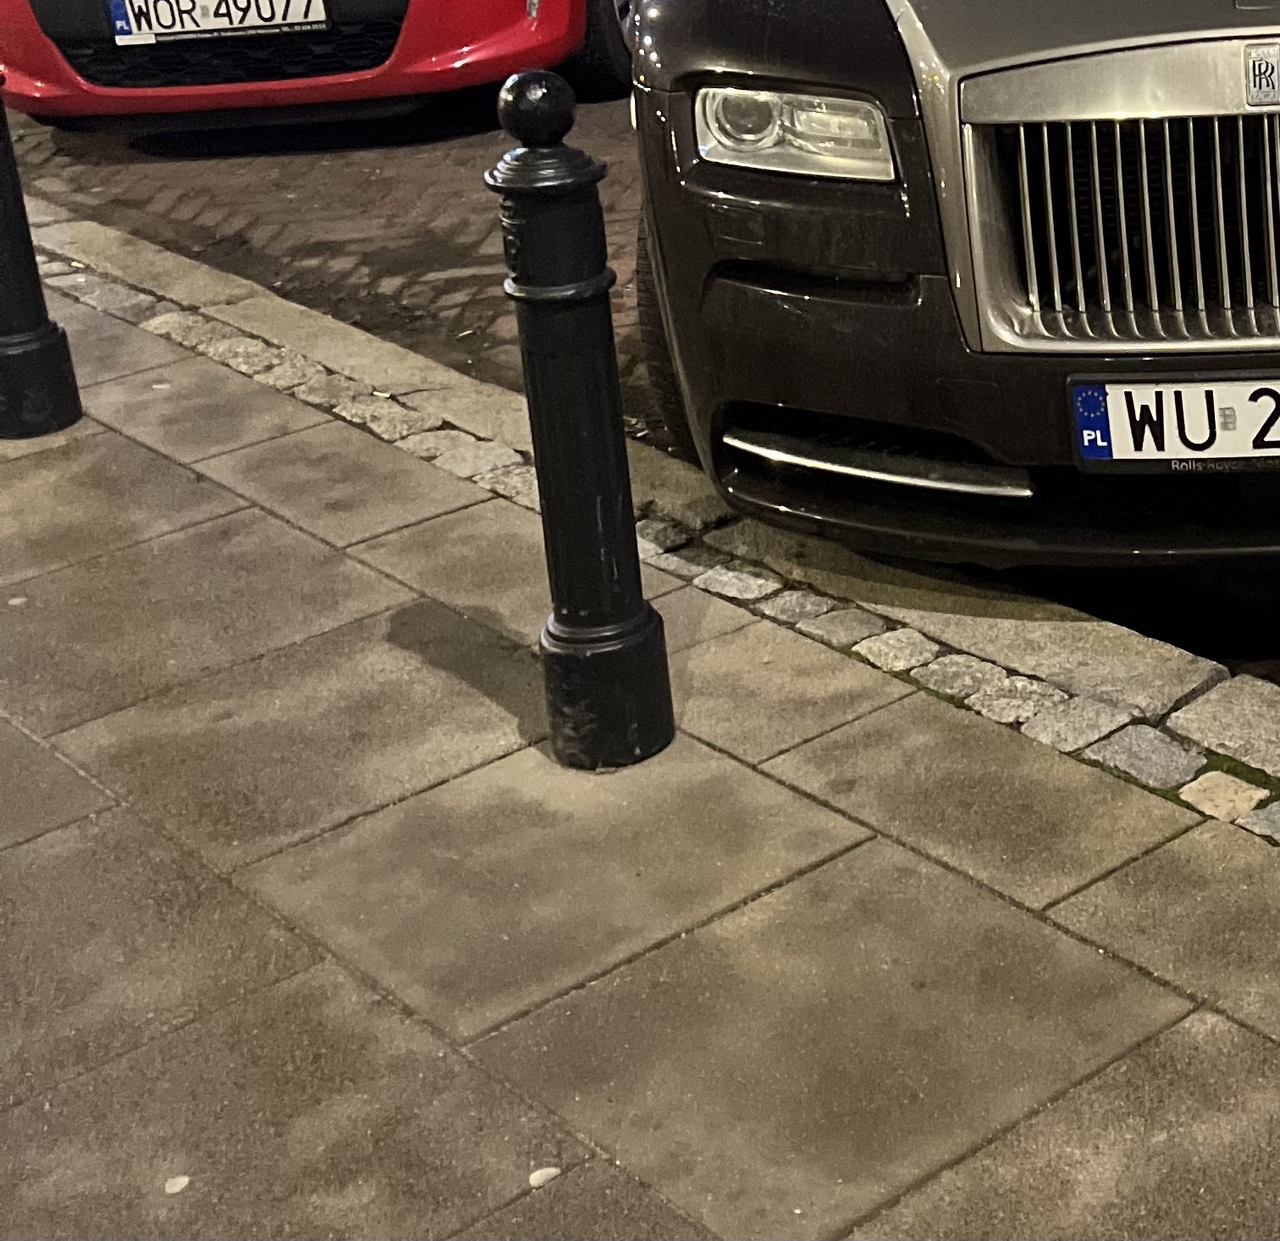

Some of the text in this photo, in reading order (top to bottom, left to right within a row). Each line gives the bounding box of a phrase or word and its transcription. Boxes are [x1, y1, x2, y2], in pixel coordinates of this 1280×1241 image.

[116, 20, 130, 31] PL
[1124, 389, 1218, 453] WU
[1082, 429, 1108, 447] PL
